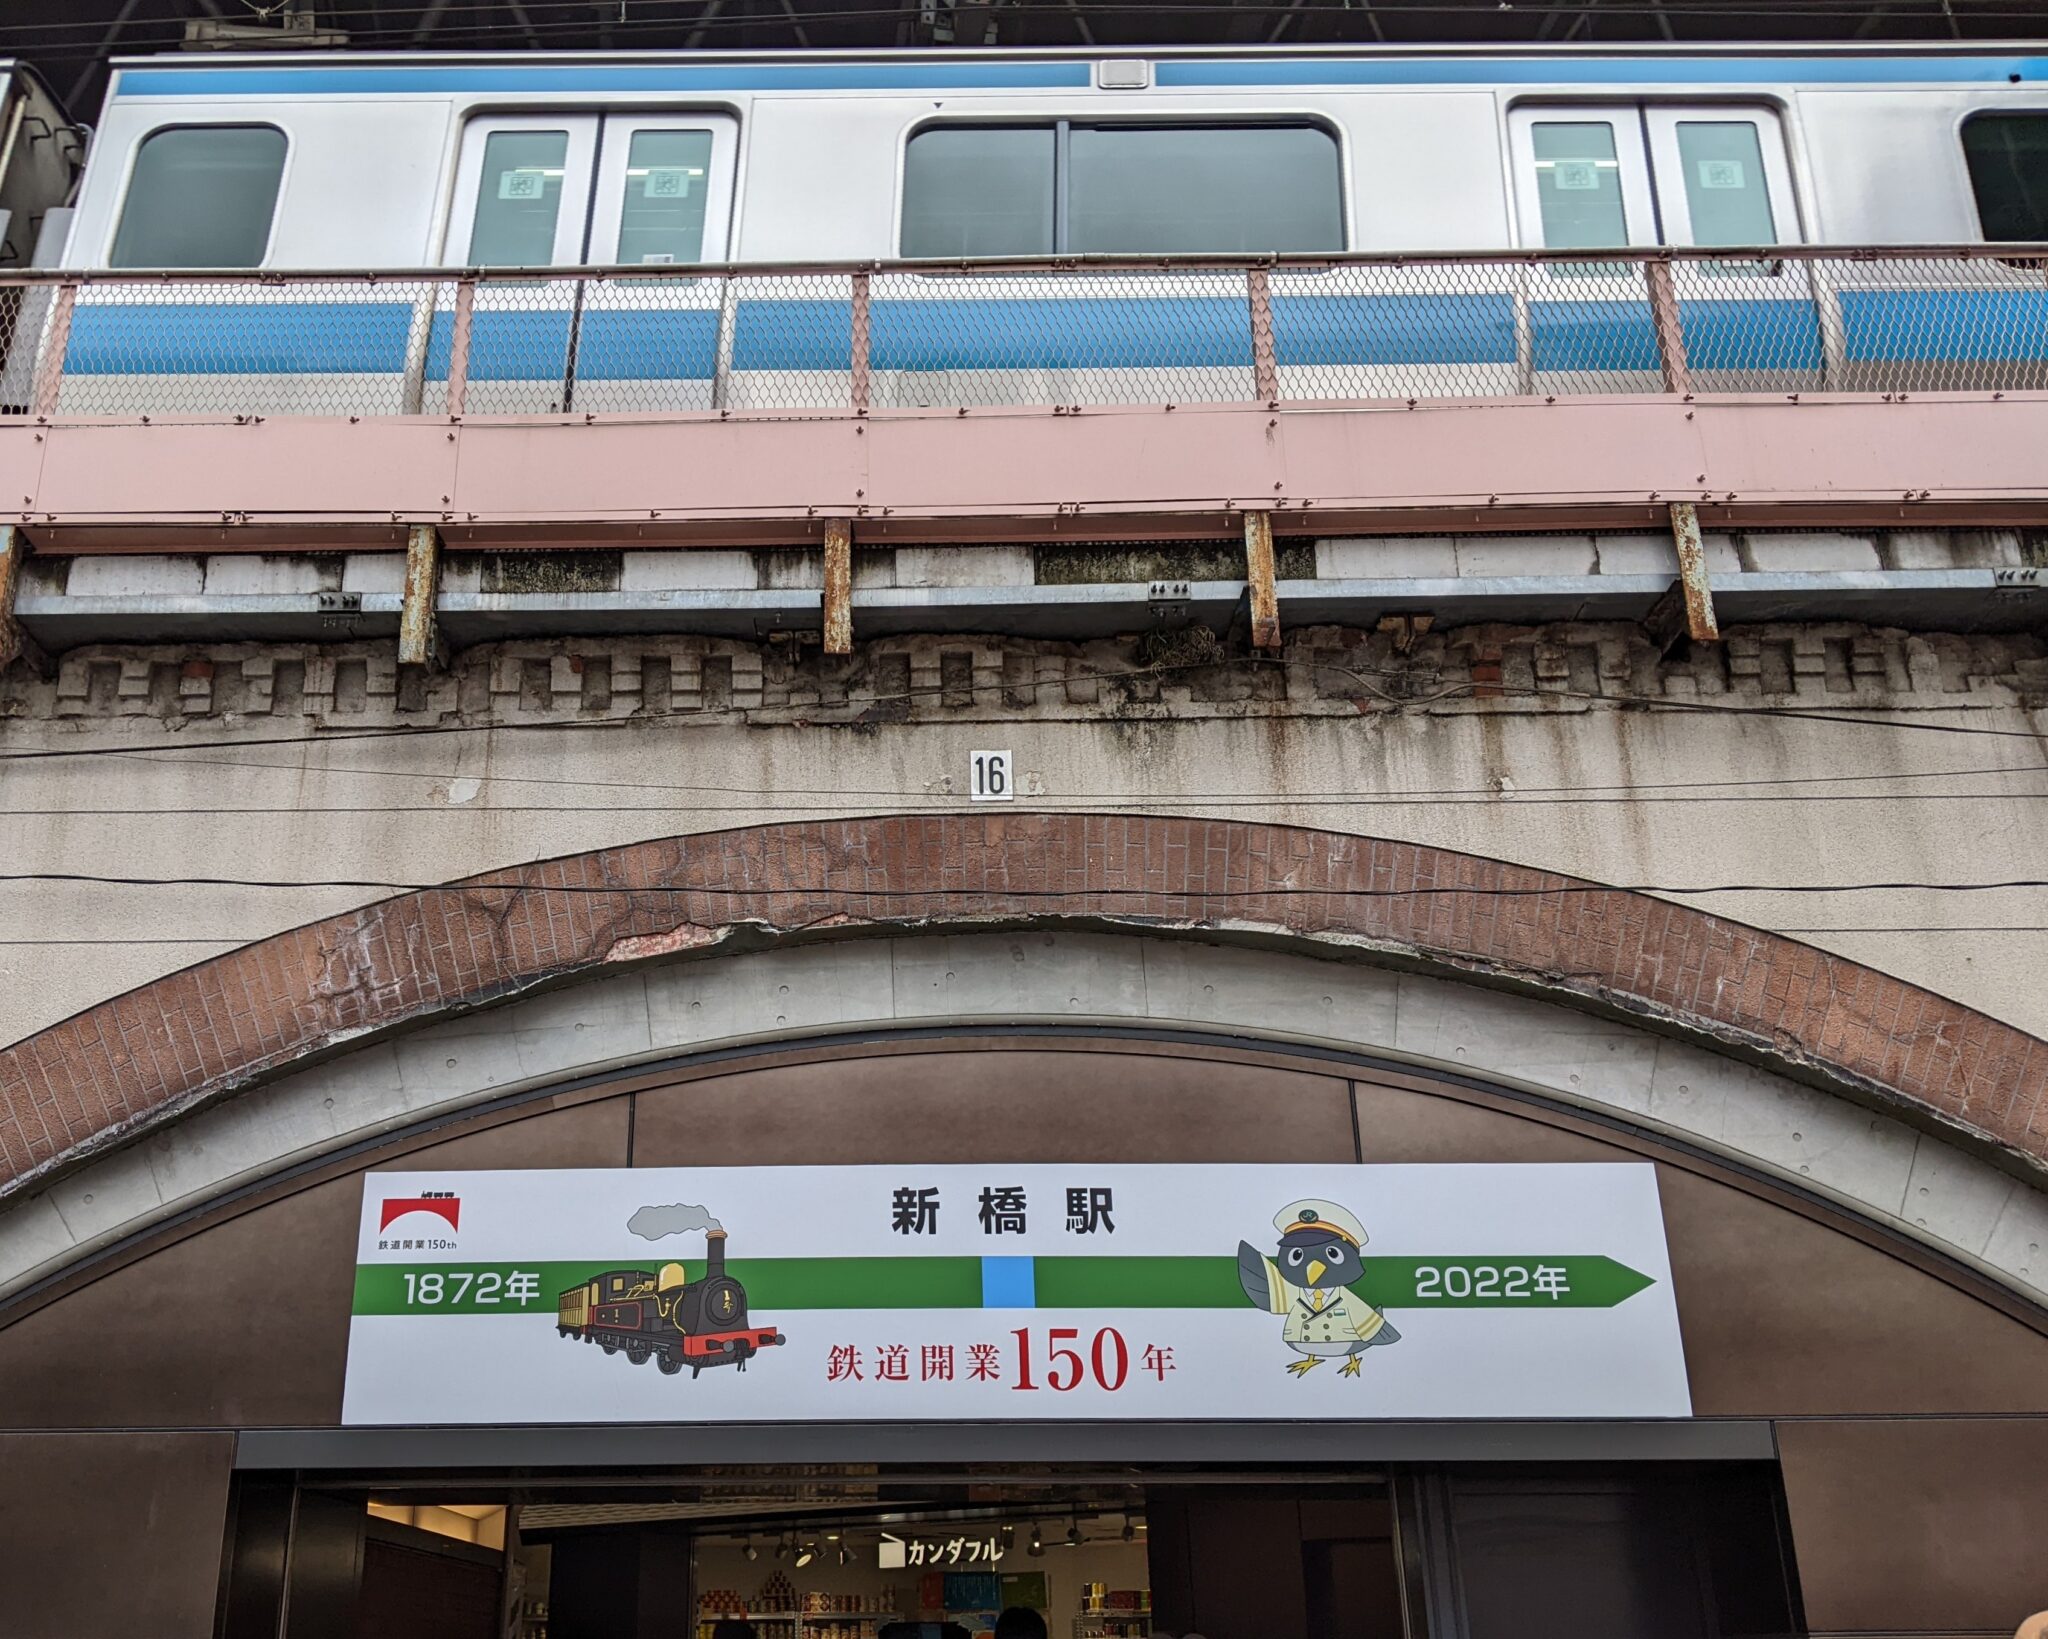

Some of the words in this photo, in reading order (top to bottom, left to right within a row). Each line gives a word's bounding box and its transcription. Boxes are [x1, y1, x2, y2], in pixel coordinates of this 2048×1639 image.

[975, 756, 1005, 795] 16
[891, 1185, 1115, 1235] 新橋駅
[403, 1270, 540, 1306] 1872年
[1415, 1264, 1570, 1301] 2022年
[827, 1327, 1176, 1392] 鉄道開業150年
[908, 1537, 1004, 1566] カンダフル
